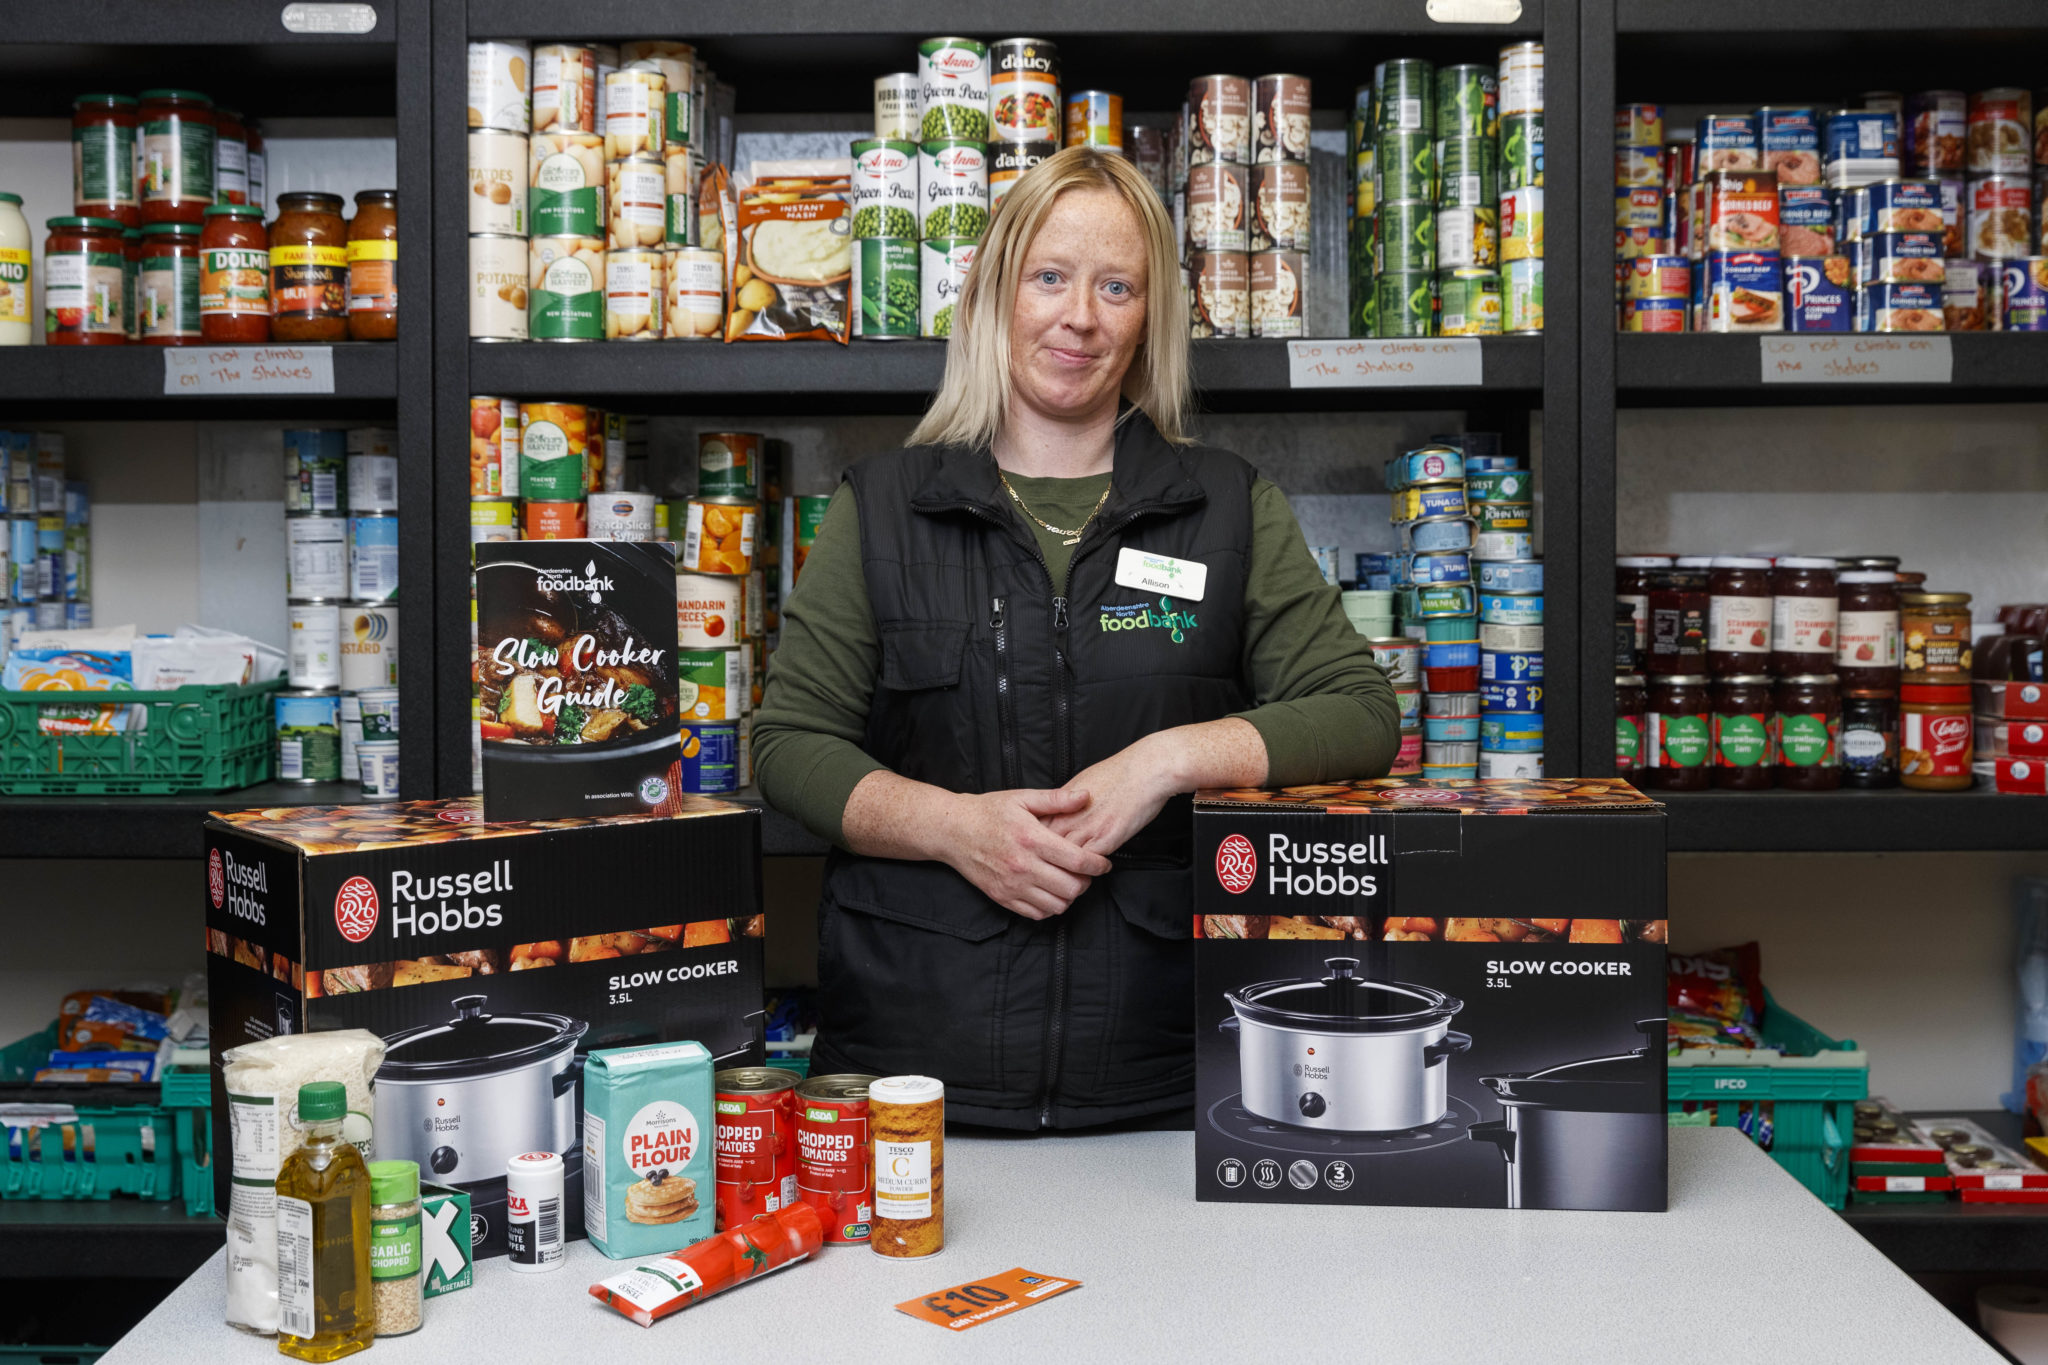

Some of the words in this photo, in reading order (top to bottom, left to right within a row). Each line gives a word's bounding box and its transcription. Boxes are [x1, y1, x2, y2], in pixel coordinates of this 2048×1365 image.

[941, 53, 975, 69] Anna
[1001, 54, 1052, 72] d'aucy
[923, 83, 956, 103] Green
[959, 83, 988, 101] Peas
[865, 152, 903, 169] Anna
[949, 150, 981, 167] Anna
[470, 168, 513, 182] TATOES
[853, 183, 882, 204] Green
[888, 183, 915, 199] Peas
[928, 181, 964, 203] Green
[780, 203, 825, 213] INSTANT
[786, 211, 817, 219] MASH
[215, 252, 269, 269] DOLMI
[957, 250, 974, 265] An
[937, 279, 961, 298] Gre
[1805, 294, 1842, 304] PRINCES
[1805, 312, 1822, 321] BEEF
[1336, 343, 1366, 356] not
[1381, 342, 1427, 356] climb
[1810, 338, 1840, 353] not
[209, 349, 239, 364] not
[254, 348, 304, 363] climb
[180, 374, 199, 386] on
[1426, 500, 1450, 508] TUNA
[1485, 510, 1512, 520] JOHN
[593, 520, 623, 530] Peach
[1143, 560, 1182, 575] foodbank
[1443, 564, 1465, 572] TUNA
[536, 574, 615, 592] foodbank
[1141, 577, 1170, 590] Allison
[677, 600, 726, 611] MANDARIN
[1100, 602, 1150, 612] Aberdeenshire
[1116, 609, 1136, 618] North
[1100, 610, 1198, 632] foodbank
[492, 637, 559, 675] Slow
[572, 634, 666, 672] Cooker
[536, 676, 631, 716] Guide
[1938, 720, 1966, 736] Lotus
[1667, 735, 1709, 746] Strawberry
[1720, 735, 1766, 746] Strawberry
[1681, 745, 1698, 754] Jam
[1733, 744, 1752, 753] Jam
[1794, 744, 1812, 753] Jam
[591, 792, 620, 800] association
[1268, 833, 1389, 865] Russell
[225, 850, 268, 895] Russell
[391, 860, 513, 903] Russell
[1269, 866, 1377, 896] Hobbs
[227, 884, 266, 926] Hobbs
[392, 899, 503, 939] Hobbs
[608, 967, 664, 991] SLOW
[666, 959, 739, 984] COOKER
[1486, 960, 1546, 975] SLOW
[1549, 960, 1632, 976] COOKER
[1486, 977, 1512, 988] 3.5L
[608, 993, 633, 1006] 3.5L
[1304, 1064, 1330, 1074] Russell
[1304, 1072, 1328, 1080] Hobbs
[1714, 1078, 1747, 1090] IFCO
[718, 1103, 741, 1113] ASDA
[435, 1115, 461, 1125] Russell
[646, 1117, 677, 1126] Morrisons
[809, 1110, 834, 1121] ASDA
[435, 1123, 460, 1132] Hobbs
[715, 1126, 762, 1141] OPPED
[631, 1127, 692, 1152] PLAIN
[715, 1139, 756, 1153] OMATOES
[797, 1129, 854, 1150] CHOPPED
[632, 1146, 691, 1169] FLOUR
[801, 1145, 848, 1162] TOMATOES
[892, 1156, 910, 1178] C
[1334, 1167, 1345, 1180] 3
[877, 1176, 903, 1186] MEDIUM
[904, 1176, 928, 1185] CURRY
[507, 1195, 529, 1211] AXA
[380, 1227, 399, 1235] ASDA
[370, 1242, 412, 1257] GARLIC
[371, 1254, 410, 1268] CHOPPED
[463, 1270, 471, 1279] 12
[439, 1278, 471, 1293] VEGETABLE
[922, 1285, 1010, 1318] £10
[949, 1316, 975, 1329] Gift
[970, 1301, 1019, 1322] Voucher
